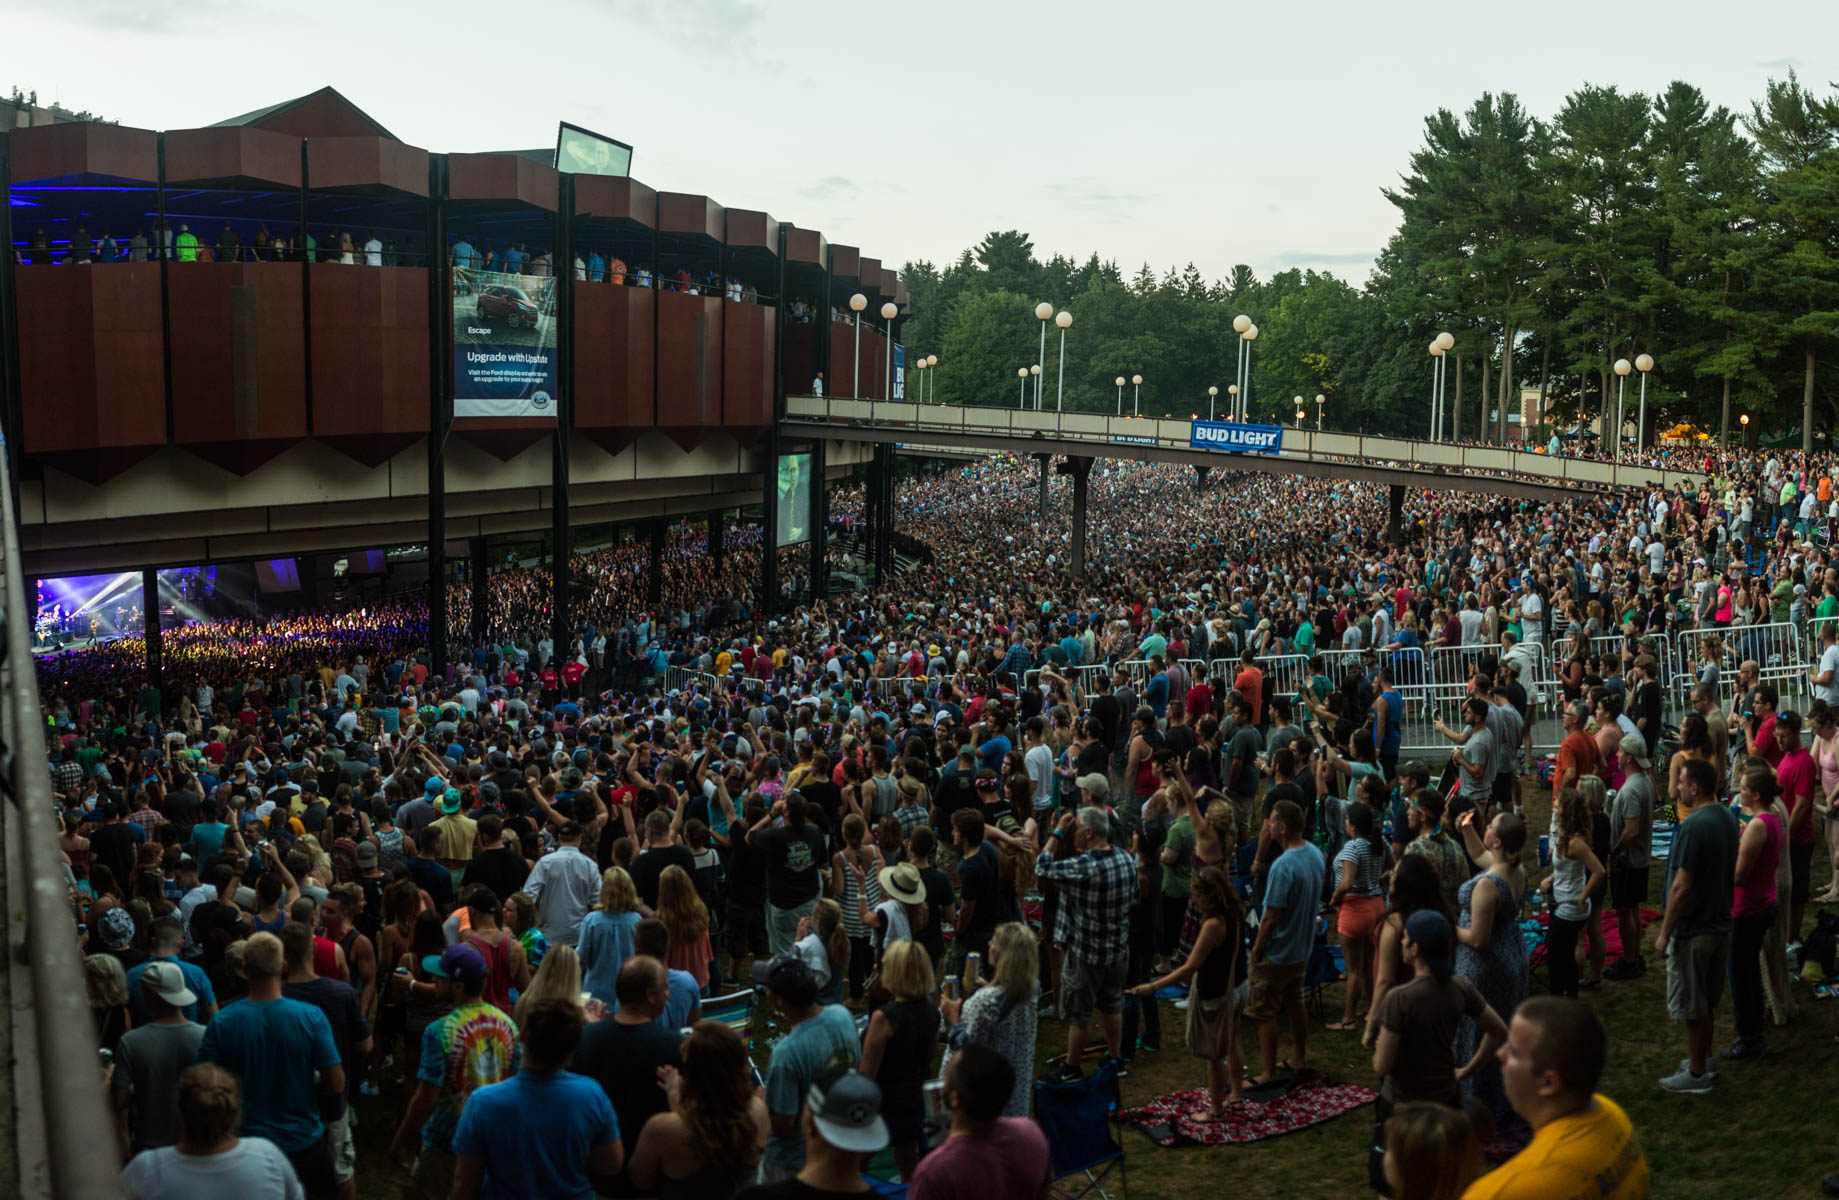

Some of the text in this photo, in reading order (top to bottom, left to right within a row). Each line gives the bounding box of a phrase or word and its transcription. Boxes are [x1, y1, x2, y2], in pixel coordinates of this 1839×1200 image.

[468, 327, 491, 335] Escape
[467, 352, 548, 364] Upgrade with Upstate
[894, 383, 904, 399] LIG
[1195, 427, 1277, 446] BUD LIGHT
